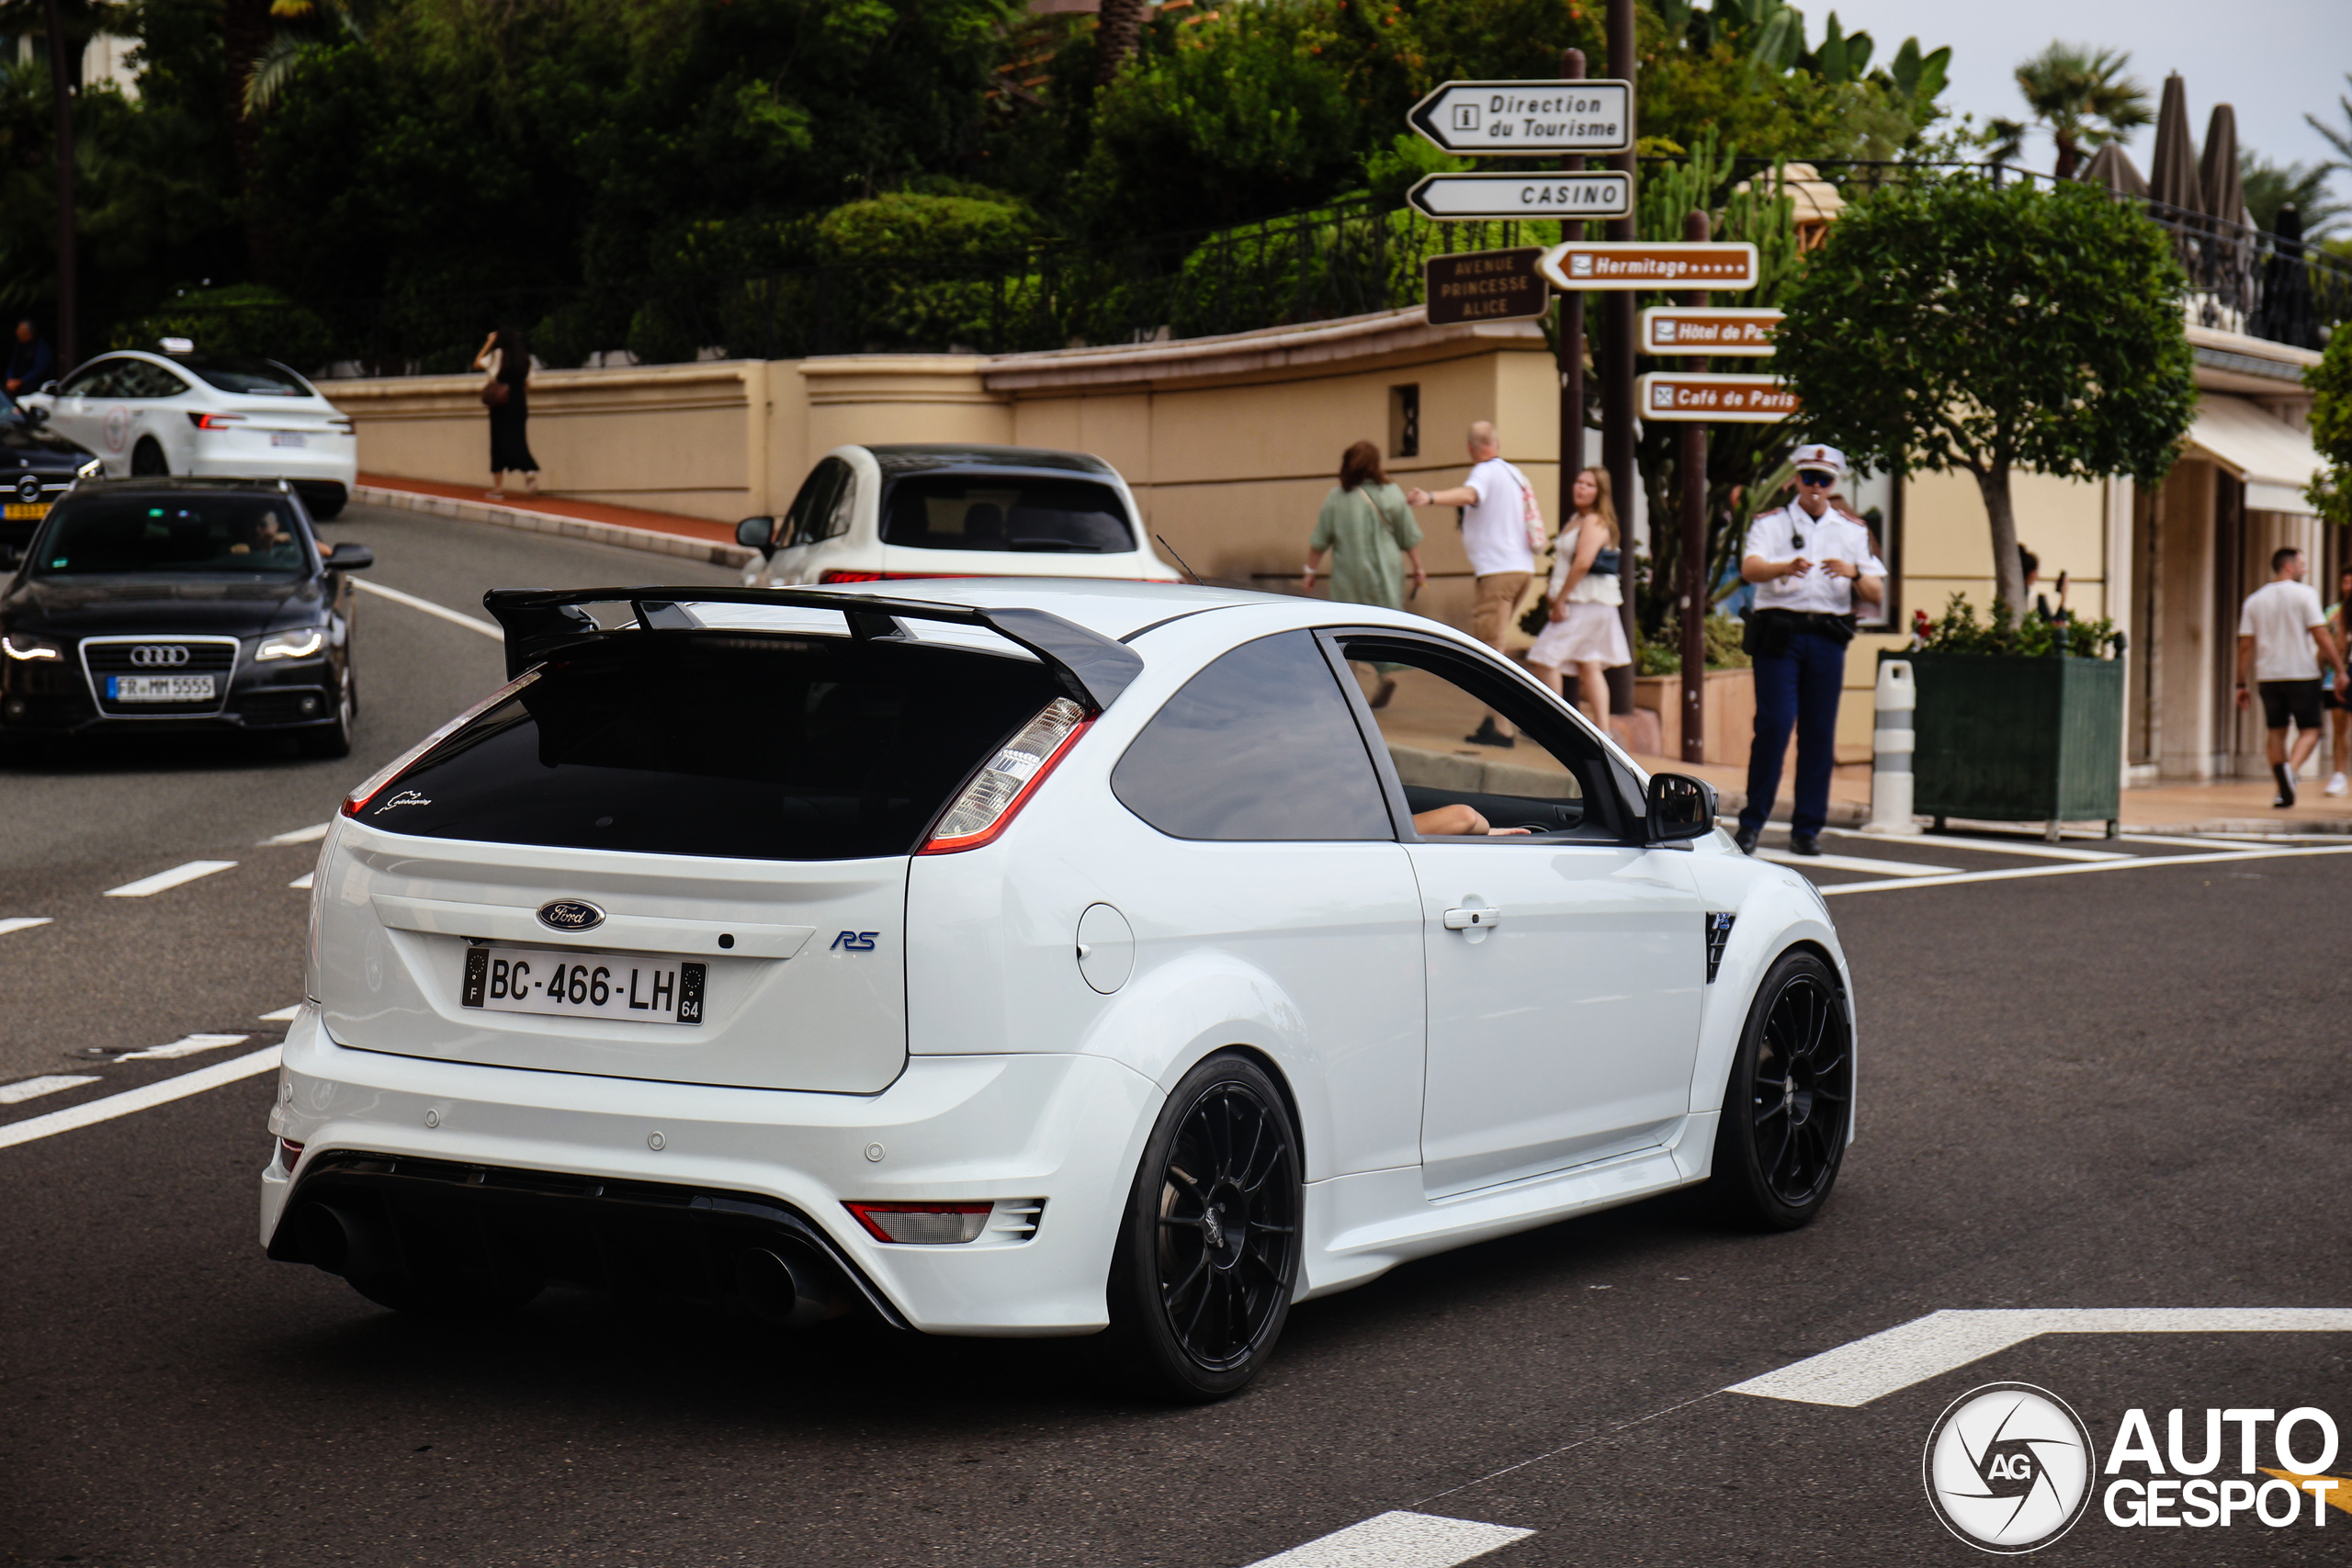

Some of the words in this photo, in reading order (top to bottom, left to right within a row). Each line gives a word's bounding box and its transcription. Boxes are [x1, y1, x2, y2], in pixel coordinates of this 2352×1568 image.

[1489, 95, 1601, 113] Direction
[1489, 119, 1513, 137] du
[1522, 118, 1618, 137] Tourisme
[1521, 186, 1617, 204] CASINO
[1454, 256, 1515, 276] AVENUE
[1595, 256, 1688, 278] Hermitage
[1441, 276, 1528, 298] PRINCESSE
[1463, 299, 1509, 316] ALICE
[1678, 322, 1719, 341] Hôtel
[1721, 323, 1741, 341] de
[1678, 388, 1718, 406] Café
[1723, 389, 1744, 407] de
[1749, 389, 1795, 407] Paris
[549, 904, 587, 924] Ford
[829, 930, 881, 953] RS
[469, 987, 478, 1000] F
[490, 958, 675, 1012] BC-466-LH
[681, 999, 700, 1019] 64
